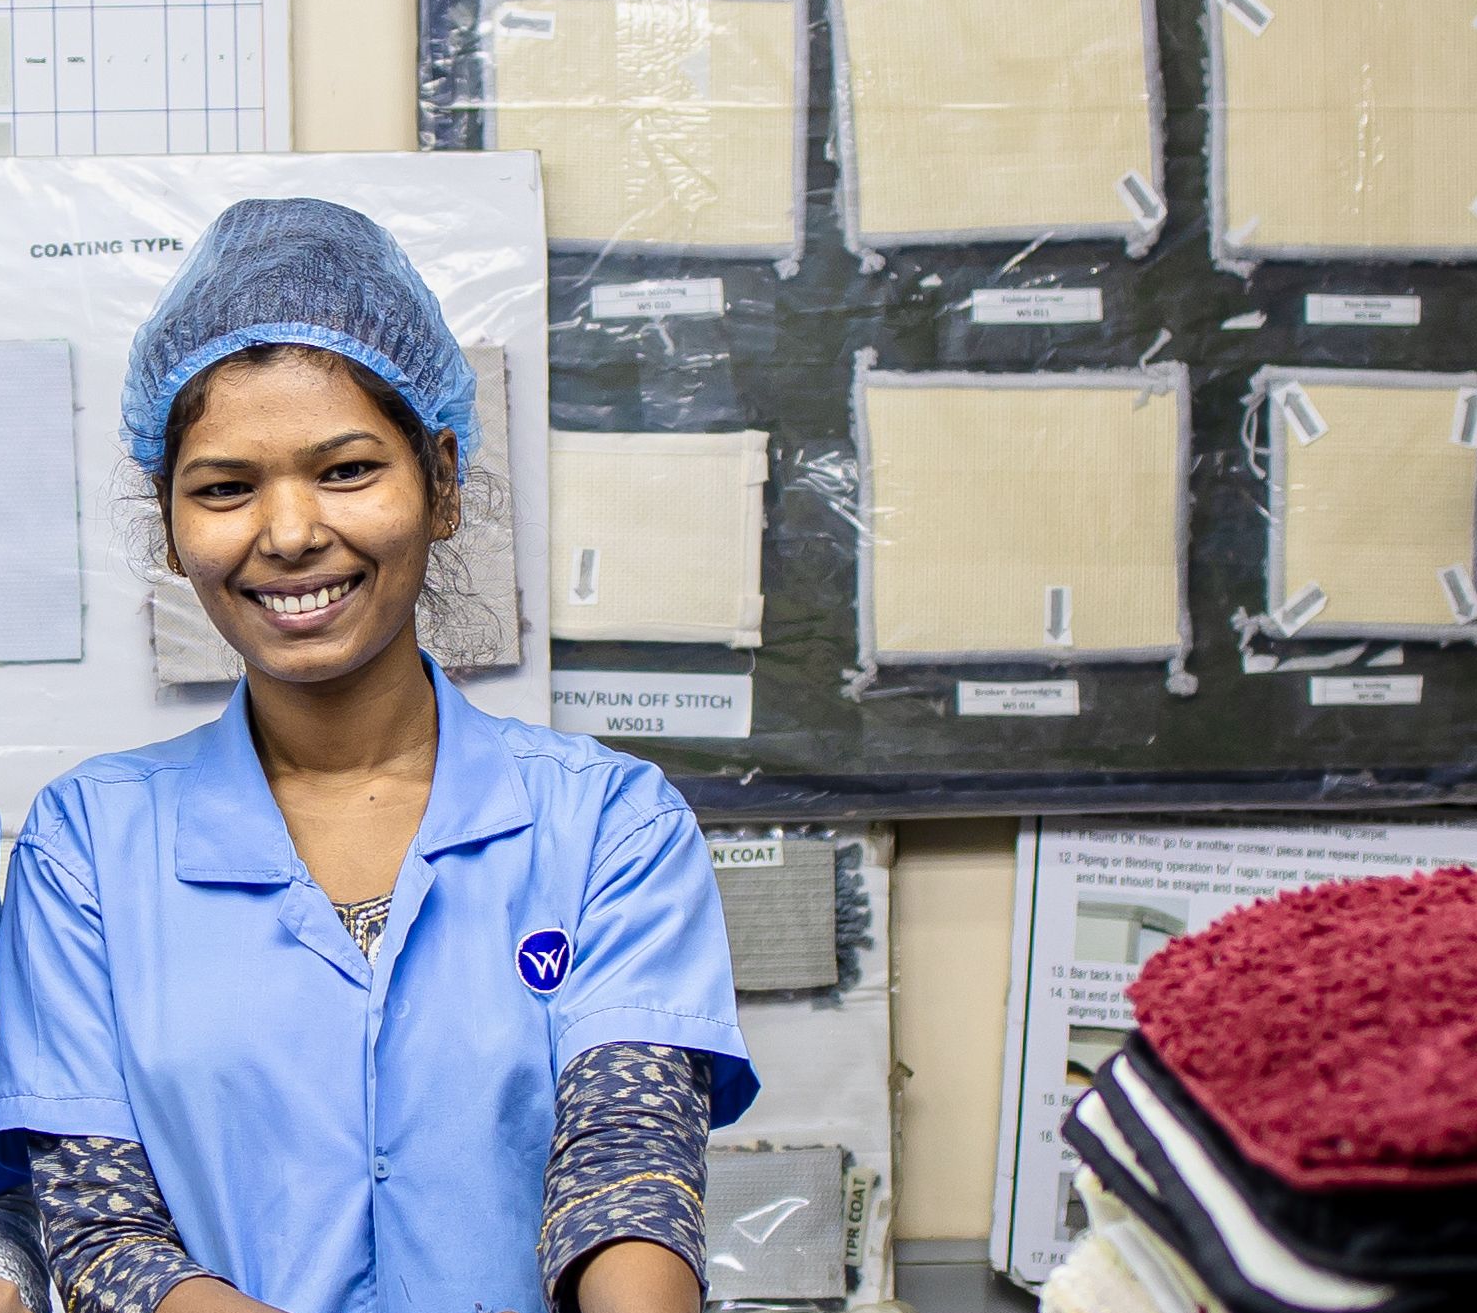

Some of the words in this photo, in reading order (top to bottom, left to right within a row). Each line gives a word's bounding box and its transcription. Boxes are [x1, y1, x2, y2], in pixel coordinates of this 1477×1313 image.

[30, 241, 124, 259] COATING
[130, 237, 184, 255] TYPE
[551, 690, 633, 710] PEN/RUN
[639, 691, 669, 710] OFF
[674, 692, 733, 711] STITCH
[606, 716, 665, 734] WS013
[730, 847, 775, 865] COAT
[1077, 852, 1109, 870] Piping
[1125, 856, 1163, 874] Binding
[1167, 860, 1214, 876] operation
[850, 1175, 867, 1224] COAT
[848, 1226, 864, 1258] TPR
